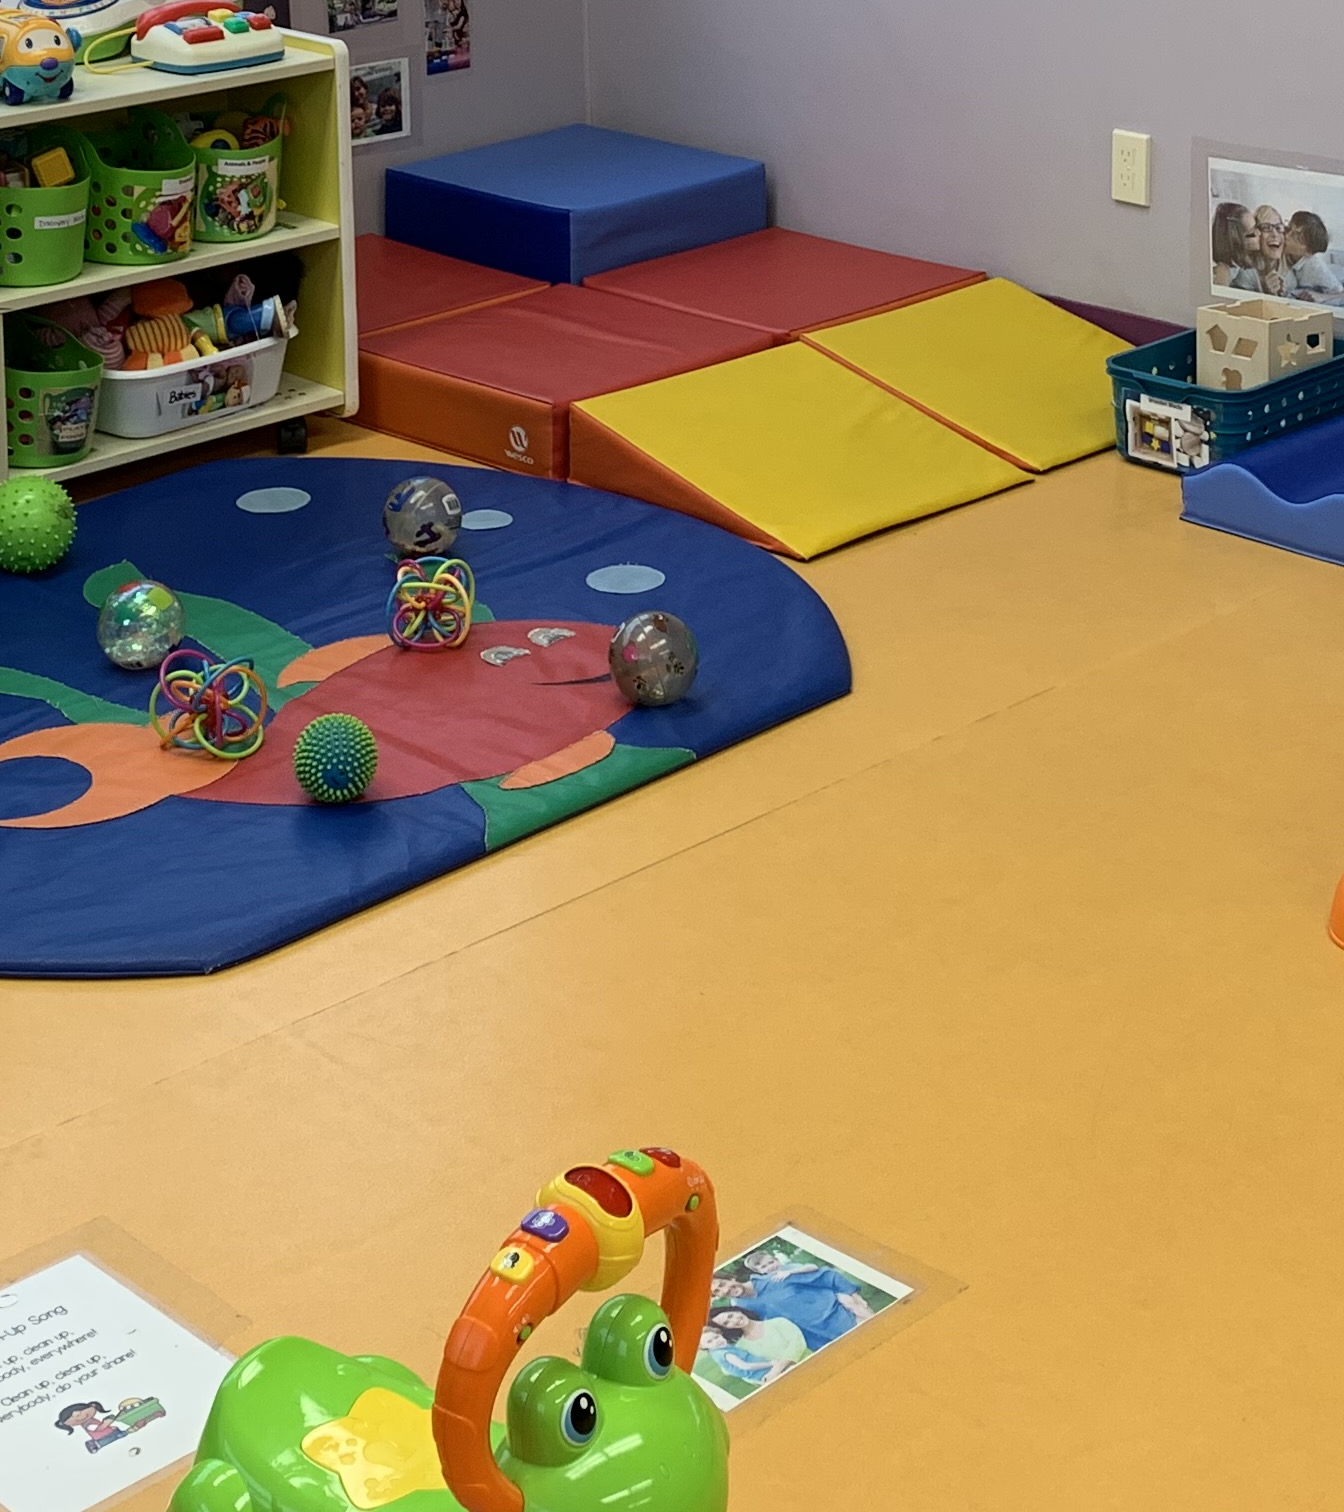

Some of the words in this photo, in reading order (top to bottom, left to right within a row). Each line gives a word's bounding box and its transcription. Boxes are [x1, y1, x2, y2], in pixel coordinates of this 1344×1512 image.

[27, 1305, 69, 1325] Song
[0, 1354, 24, 1369] up,
[23, 1338, 54, 1356] clean
[54, 1329, 75, 1345] up,
[30, 1328, 98, 1366] everywhere!
[0, 1388, 34, 1407] Clean
[34, 1379, 55, 1393] up,
[54, 1362, 86, 1380] clean
[86, 1353, 107, 1368] up,
[55, 1381, 72, 1395] do
[73, 1368, 99, 1386] your
[101, 1348, 136, 1371] share!
